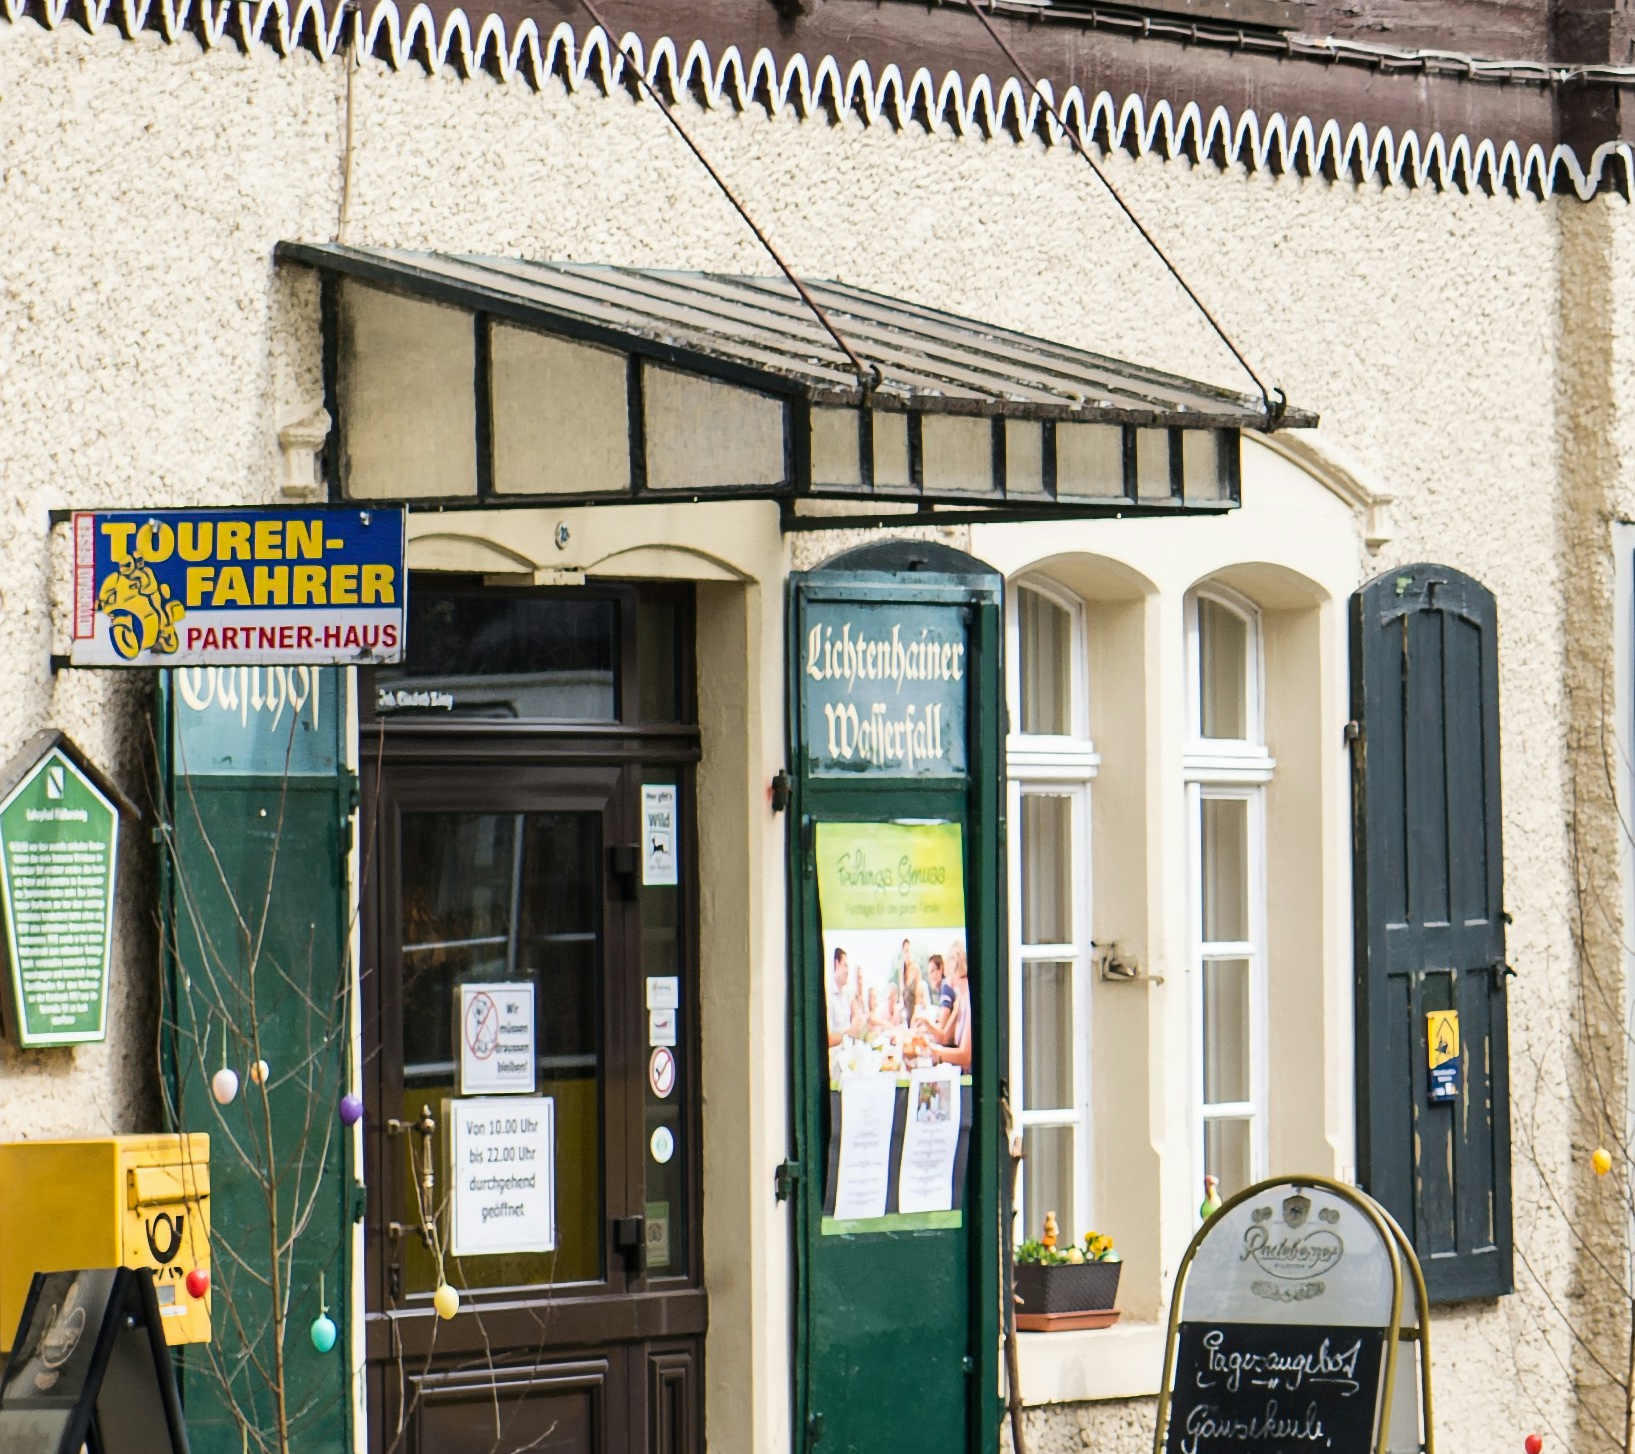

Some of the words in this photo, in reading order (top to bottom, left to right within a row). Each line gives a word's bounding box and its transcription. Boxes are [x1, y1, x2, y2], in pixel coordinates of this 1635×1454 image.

[101, 520, 344, 563] TOUREN-
[186, 564, 396, 606] FAHRER
[187, 625, 397, 651] PARTNER-HAUS
[806, 622, 965, 695] Lichtenhainer
[466, 1120, 485, 1135] Von
[489, 1119, 518, 1135] 10.00
[520, 1118, 539, 1133] Uhr
[469, 1146, 483, 1163] bis
[488, 1147, 516, 1162] 22.00
[518, 1146, 536, 1161] Uhr
[469, 1171, 536, 1195] durchgehend
[481, 1201, 525, 1224] geöffnet
